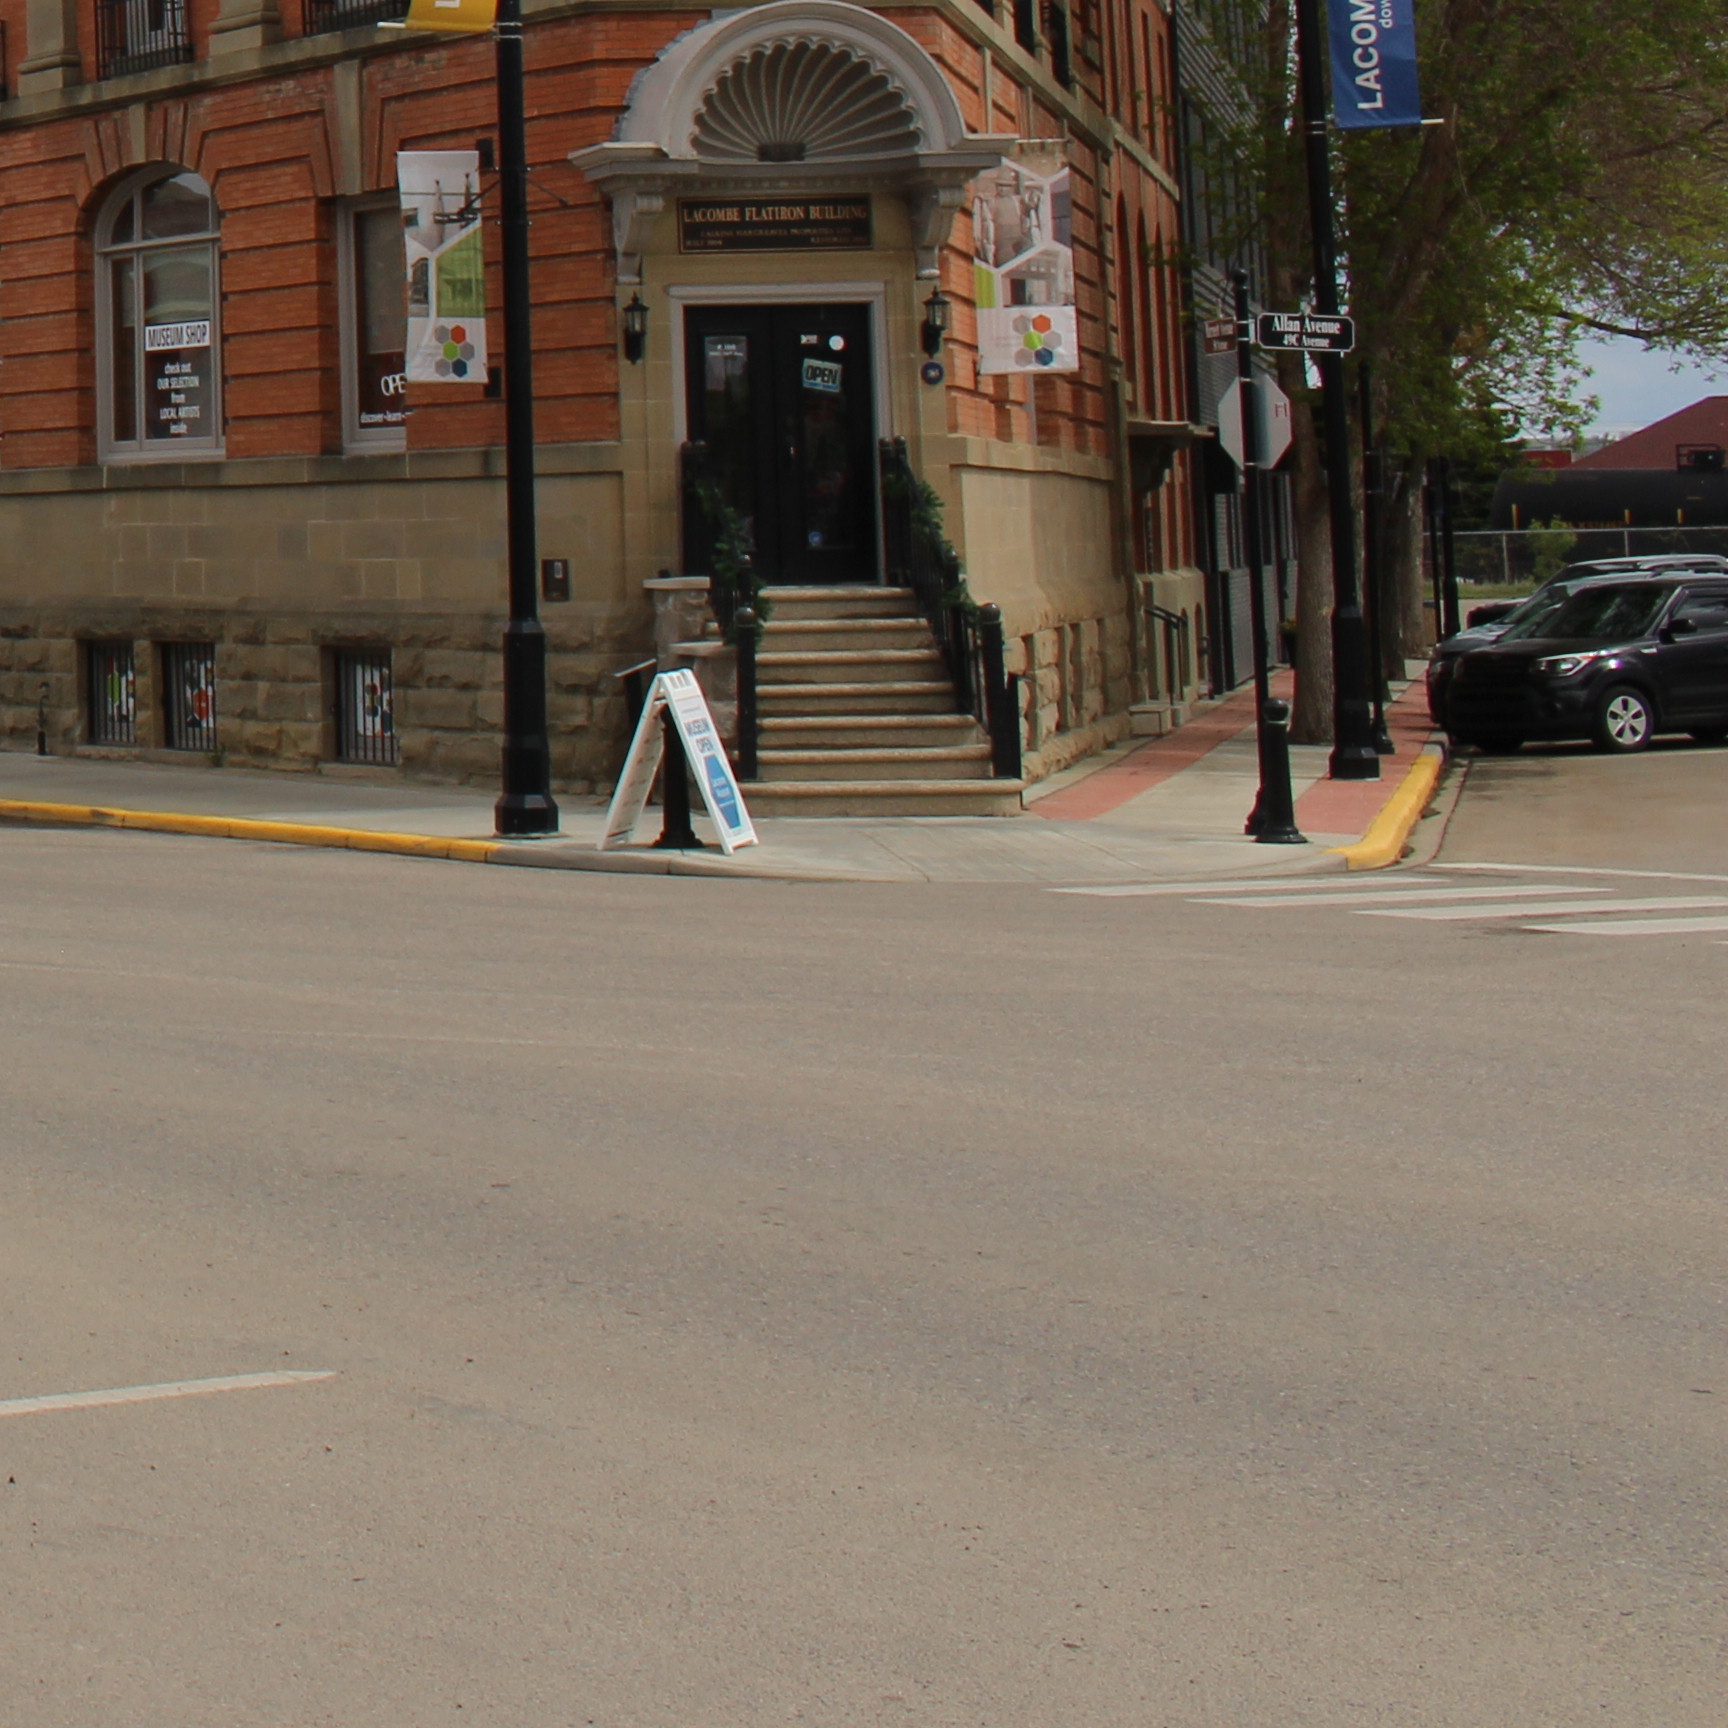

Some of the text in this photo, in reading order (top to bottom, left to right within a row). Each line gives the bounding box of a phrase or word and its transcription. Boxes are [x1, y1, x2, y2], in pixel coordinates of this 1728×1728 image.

[683, 205, 867, 222] LACOMBE FLATIRON BUILDING
[1272, 316, 1341, 334] Allan Avenue
[148, 324, 207, 347] MUSEUM SHOP
[1282, 334, 1330, 348] 49C Avenue
[381, 373, 407, 396] OPE
[806, 365, 839, 385] OPEN
